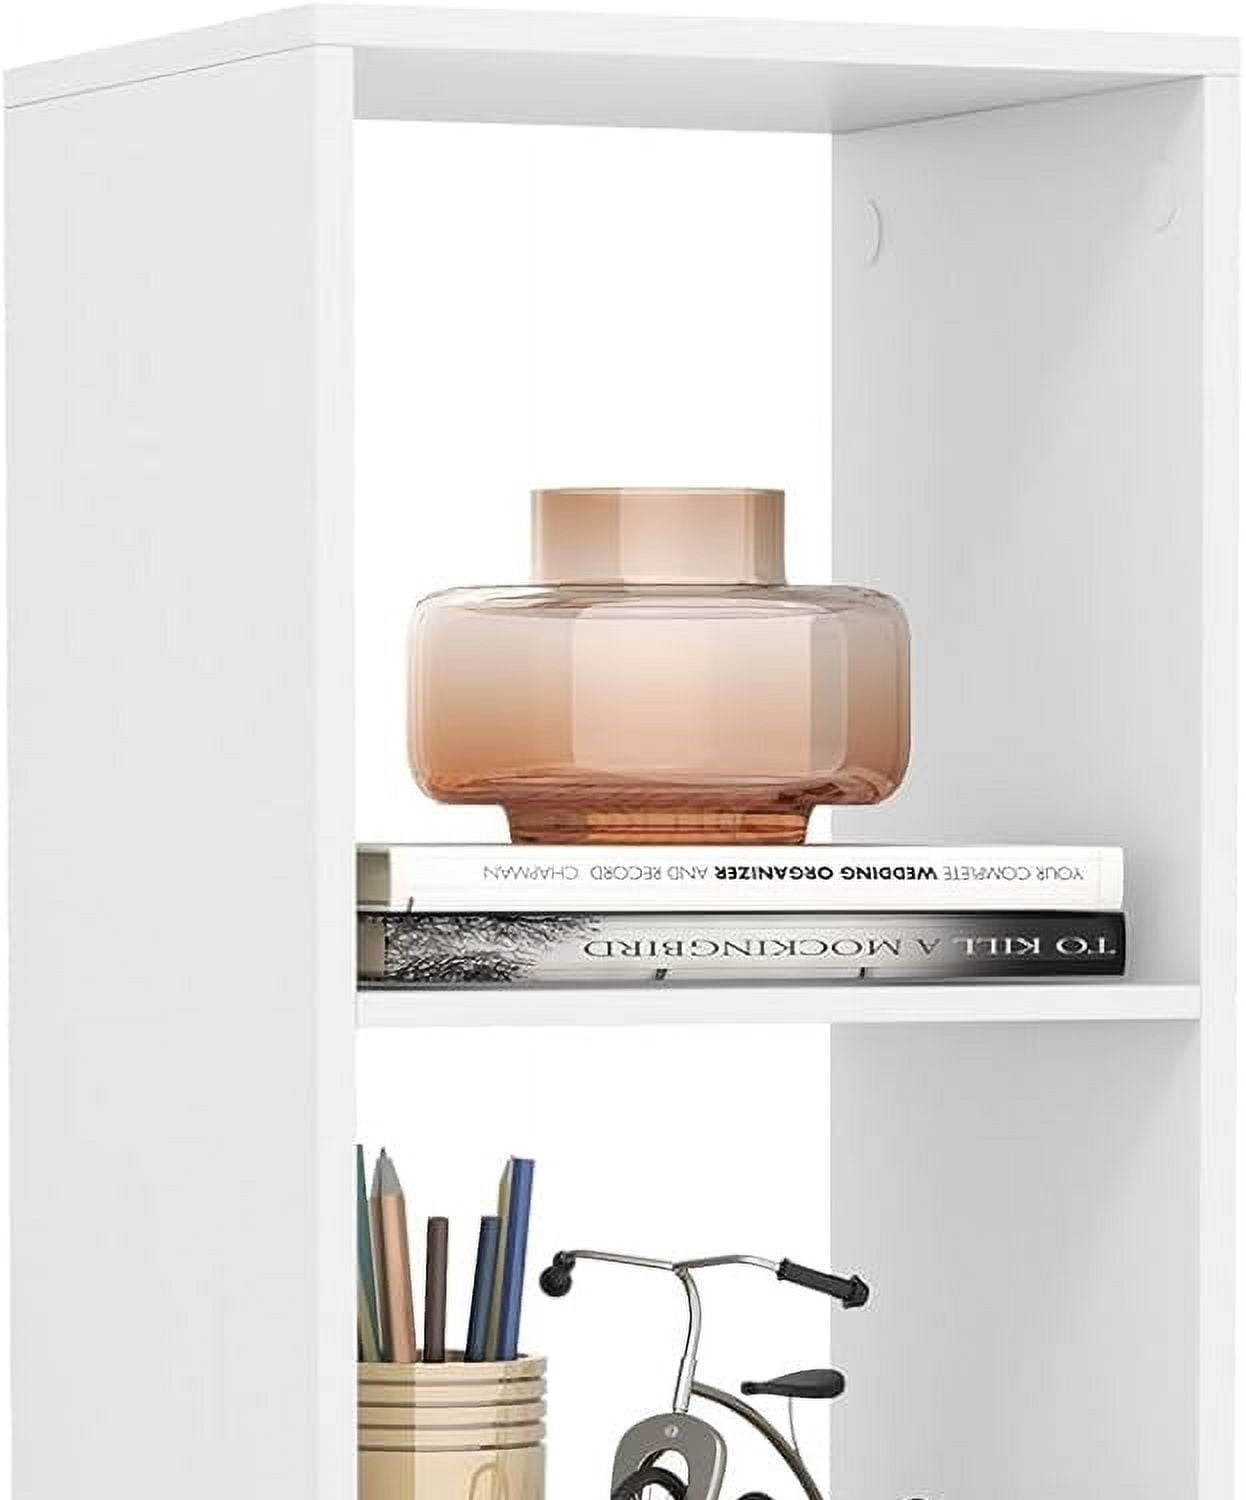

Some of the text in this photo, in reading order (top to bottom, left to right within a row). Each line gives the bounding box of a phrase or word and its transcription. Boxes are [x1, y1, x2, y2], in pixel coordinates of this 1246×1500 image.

[483, 865, 579, 881] CHAPMAN
[589, 865, 662, 881] RECORD
[667, 865, 707, 881] AND
[714, 865, 834, 881] ORGANIZER
[840, 865, 938, 881] WEDDING
[1038, 865, 1085, 881] YOUR
[583, 936, 1117, 958] TO KILL A MOCKINGBIRD
